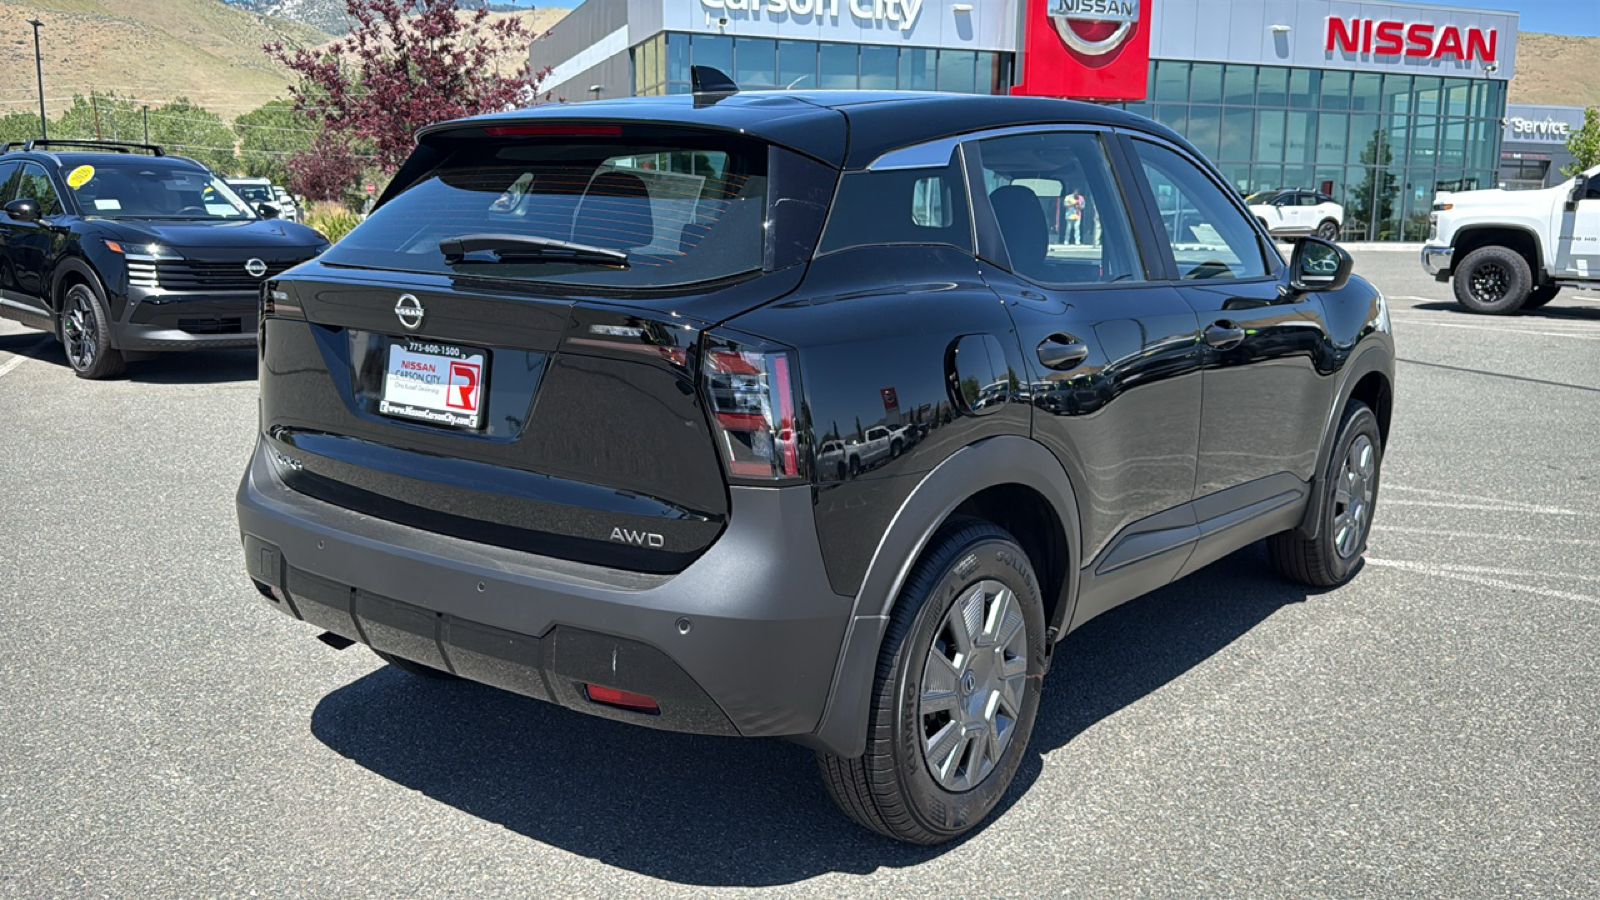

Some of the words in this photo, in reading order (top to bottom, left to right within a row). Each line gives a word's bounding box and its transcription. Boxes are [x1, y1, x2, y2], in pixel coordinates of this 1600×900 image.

[848, 0, 922, 30] City
[1059, 0, 1133, 16] NISSAN
[1325, 16, 1498, 62] NISSAN
[1513, 118, 1570, 135] Service
[408, 342, 460, 356] 775-600-1500
[400, 360, 436, 373] NISSAN
[394, 369, 425, 383] CARSON
[425, 373, 441, 385] CITY
[610, 526, 665, 548] AWD
[995, 550, 1032, 588] SOLUS
[904, 682, 918, 777] KUMHO
